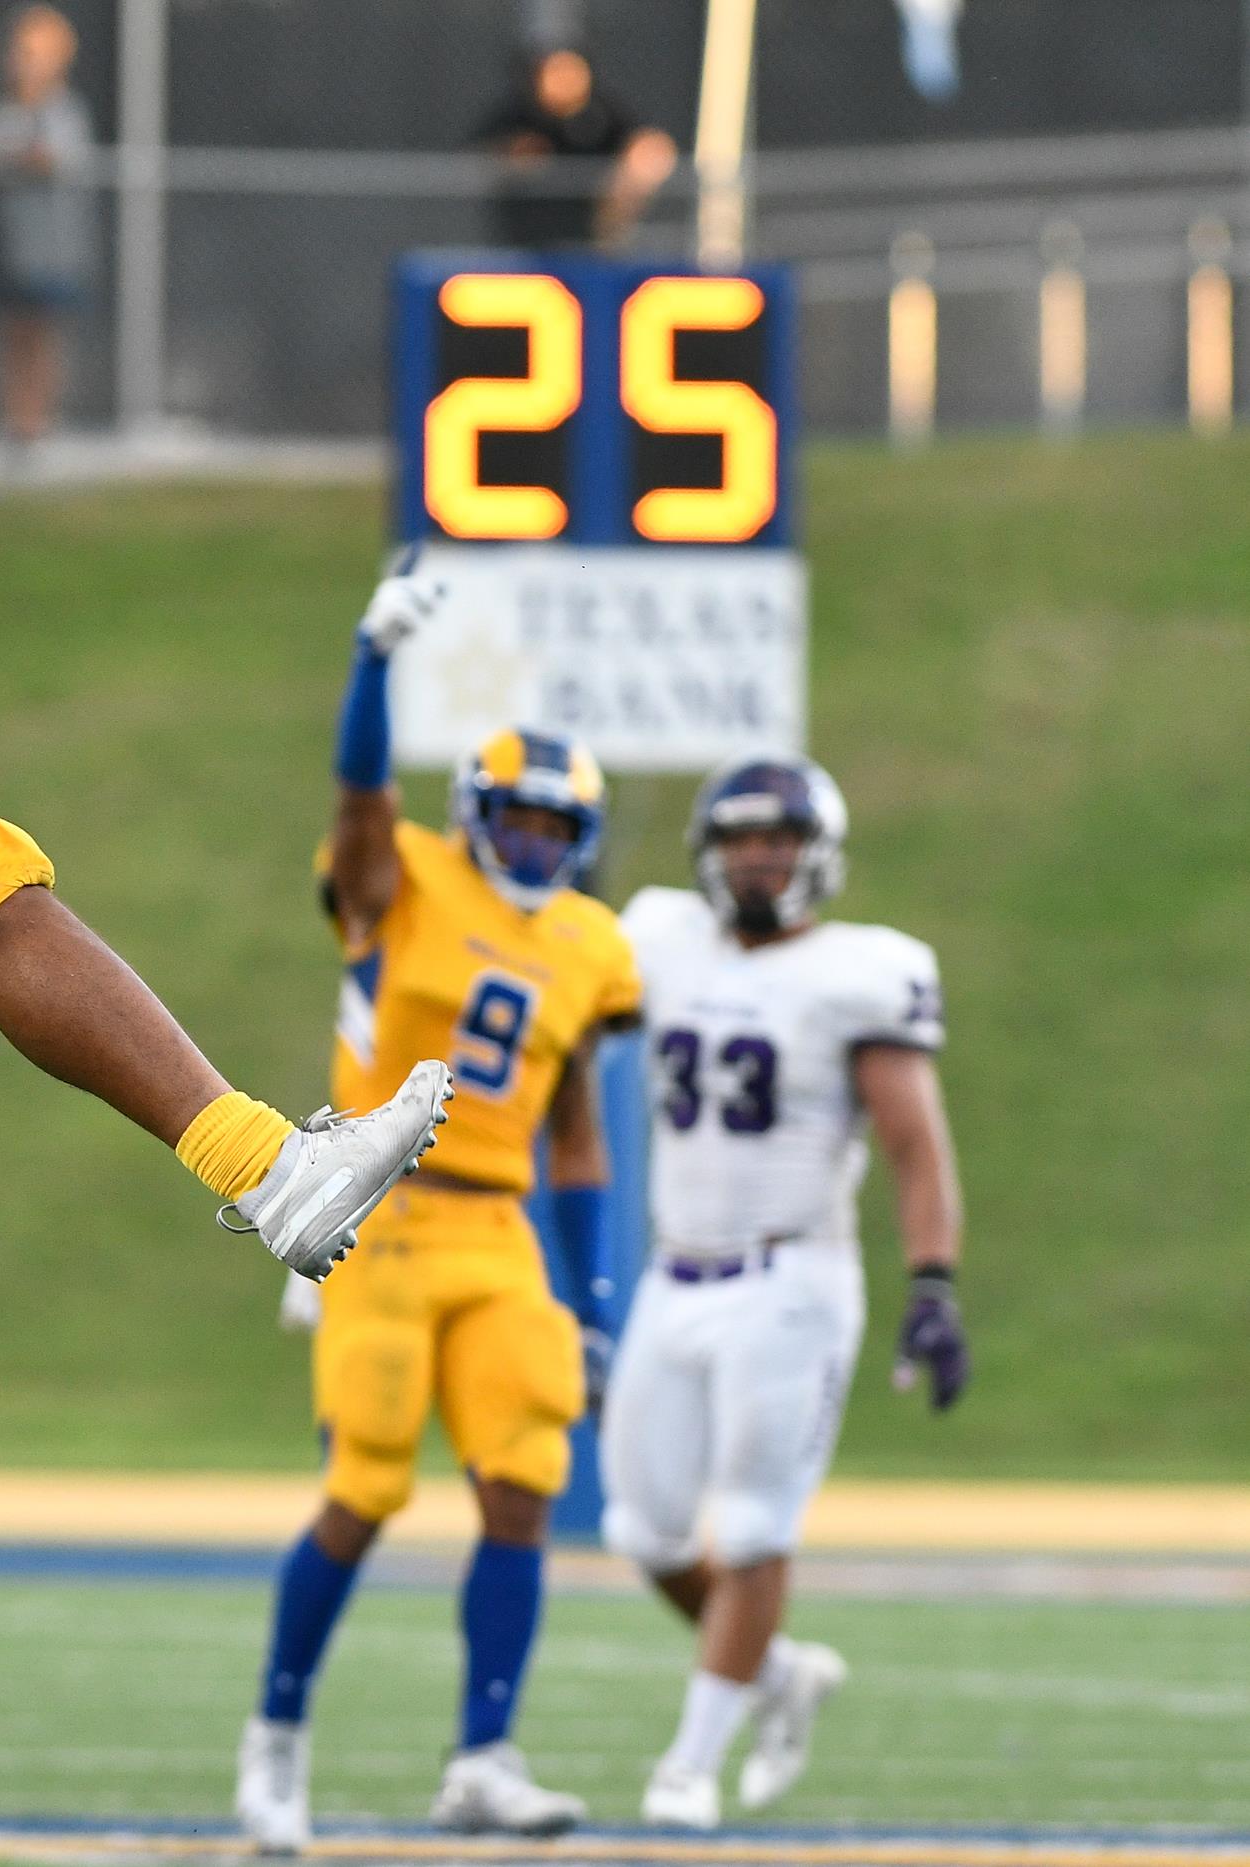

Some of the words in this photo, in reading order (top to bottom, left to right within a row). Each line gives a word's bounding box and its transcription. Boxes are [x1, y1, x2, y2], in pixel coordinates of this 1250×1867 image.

[424, 273, 777, 543] 25
[452, 973, 533, 1096] 9
[660, 1027, 779, 1135] 33
